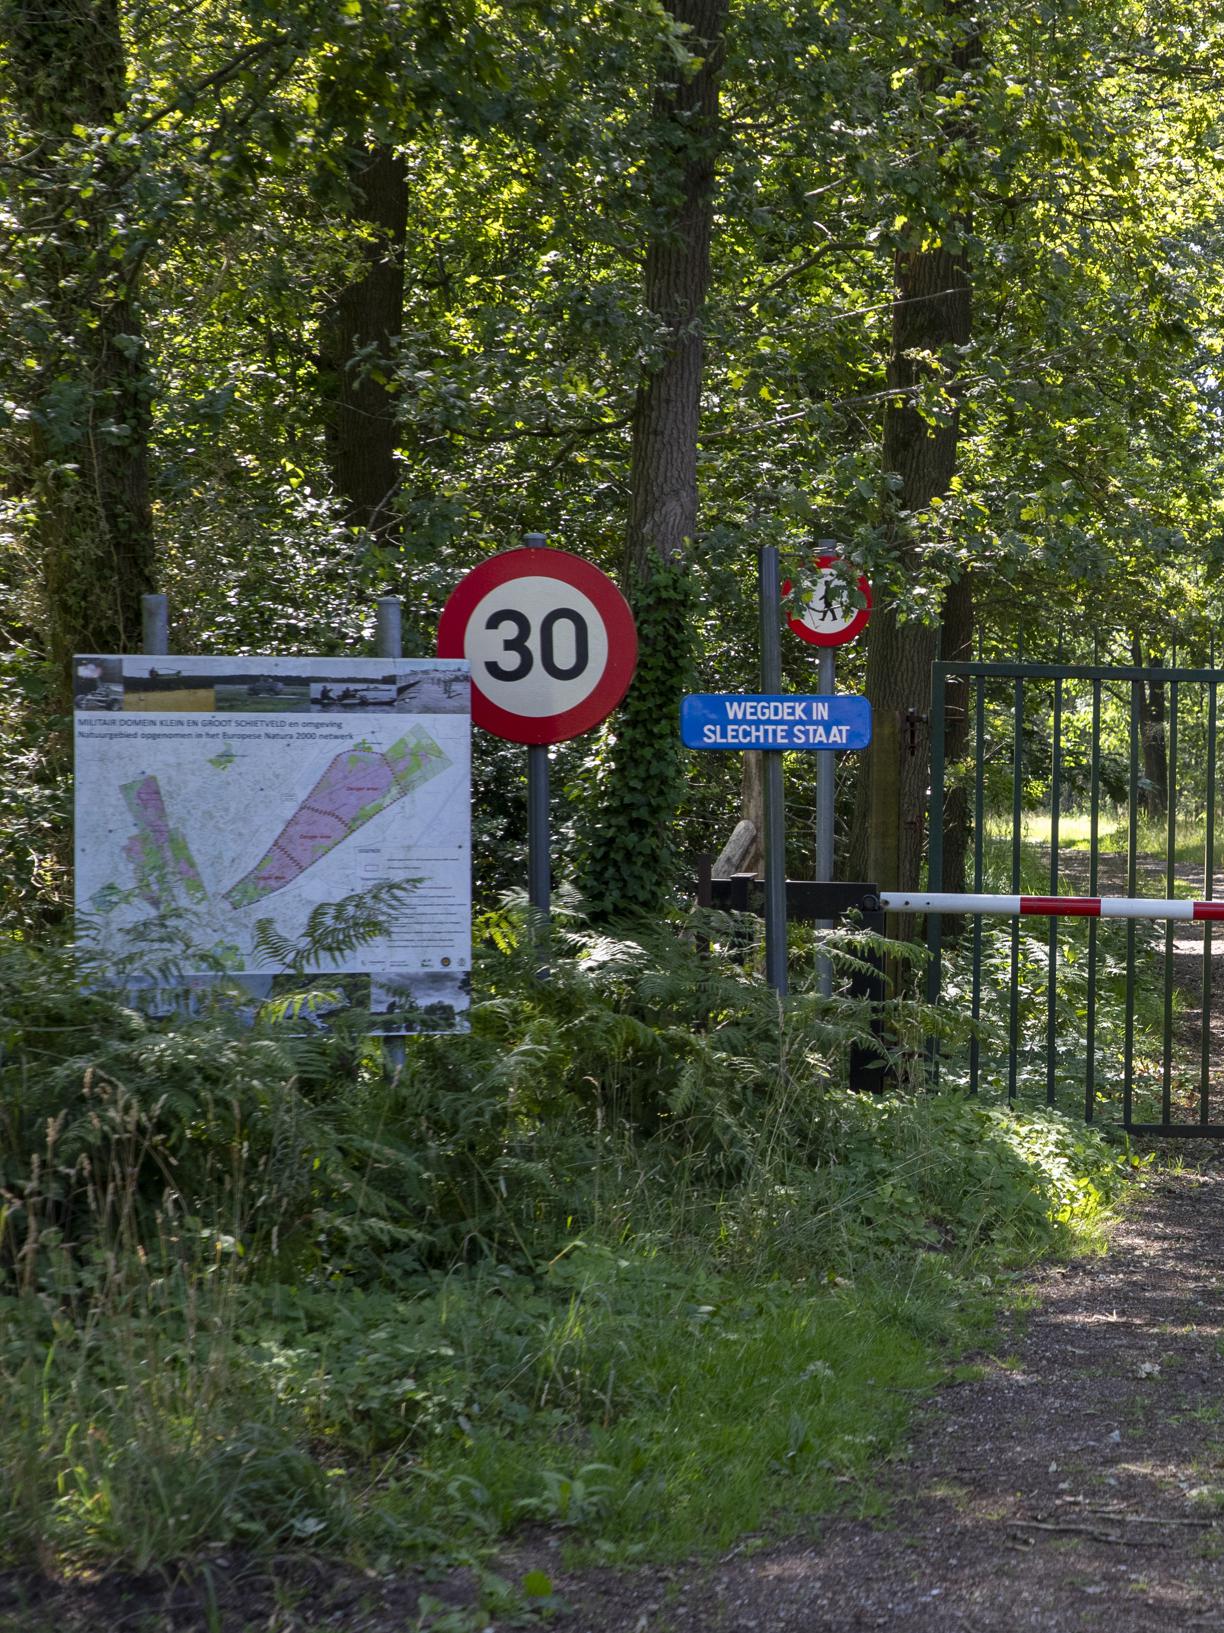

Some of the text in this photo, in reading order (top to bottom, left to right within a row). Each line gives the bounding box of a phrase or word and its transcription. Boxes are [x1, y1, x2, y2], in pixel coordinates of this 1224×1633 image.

[484, 607, 589, 682] 30
[725, 701, 828, 721] WEGDEK IN
[78, 719, 117, 727] MILITAIR
[119, 719, 157, 727] DOMEIN
[160, 719, 184, 727] KLEIN
[186, 719, 198, 727] EN
[200, 719, 232, 728] GROOT
[235, 720, 287, 728] SCHIETVELD
[301, 721, 343, 730] omgeving
[140, 732, 193, 740] opgenomen
[222, 731, 262, 741] Europese
[264, 732, 294, 740] Natura
[295, 732, 317, 740] 2000
[318, 732, 354, 740] netwerk
[703, 725, 850, 744] SLECHTE STAAT
